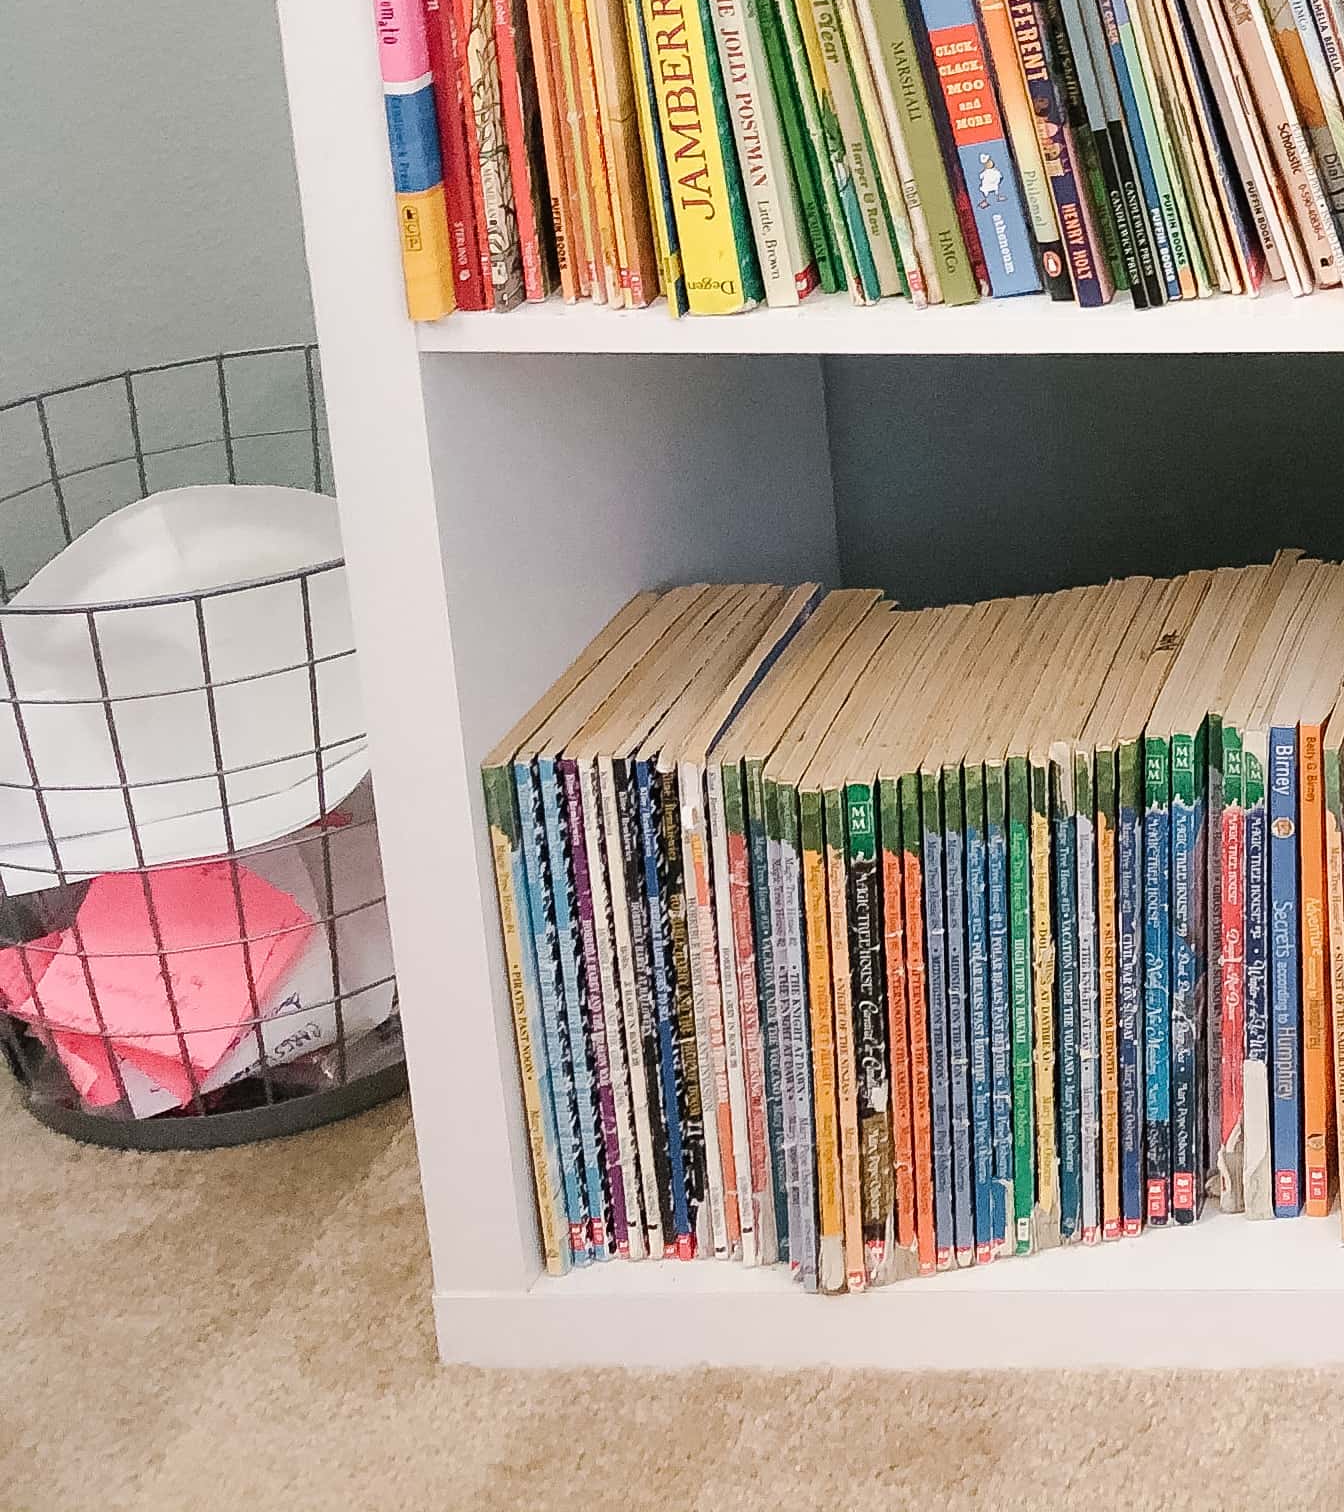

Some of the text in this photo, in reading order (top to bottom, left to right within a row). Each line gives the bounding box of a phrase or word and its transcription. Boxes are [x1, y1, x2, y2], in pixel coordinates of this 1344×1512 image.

[718, 28, 747, 84] JOLLY
[892, 41, 921, 122] MARSHALL
[728, 94, 767, 187] POSTMAN
[758, 201, 774, 236] Little,
[1061, 203, 1085, 247] HENRY
[764, 240, 781, 280] Brown
[1072, 251, 1092, 281] HOLT
[687, 279, 736, 295] Degen
[1273, 745, 1296, 1100] Birney Secrets according to Humphrey
